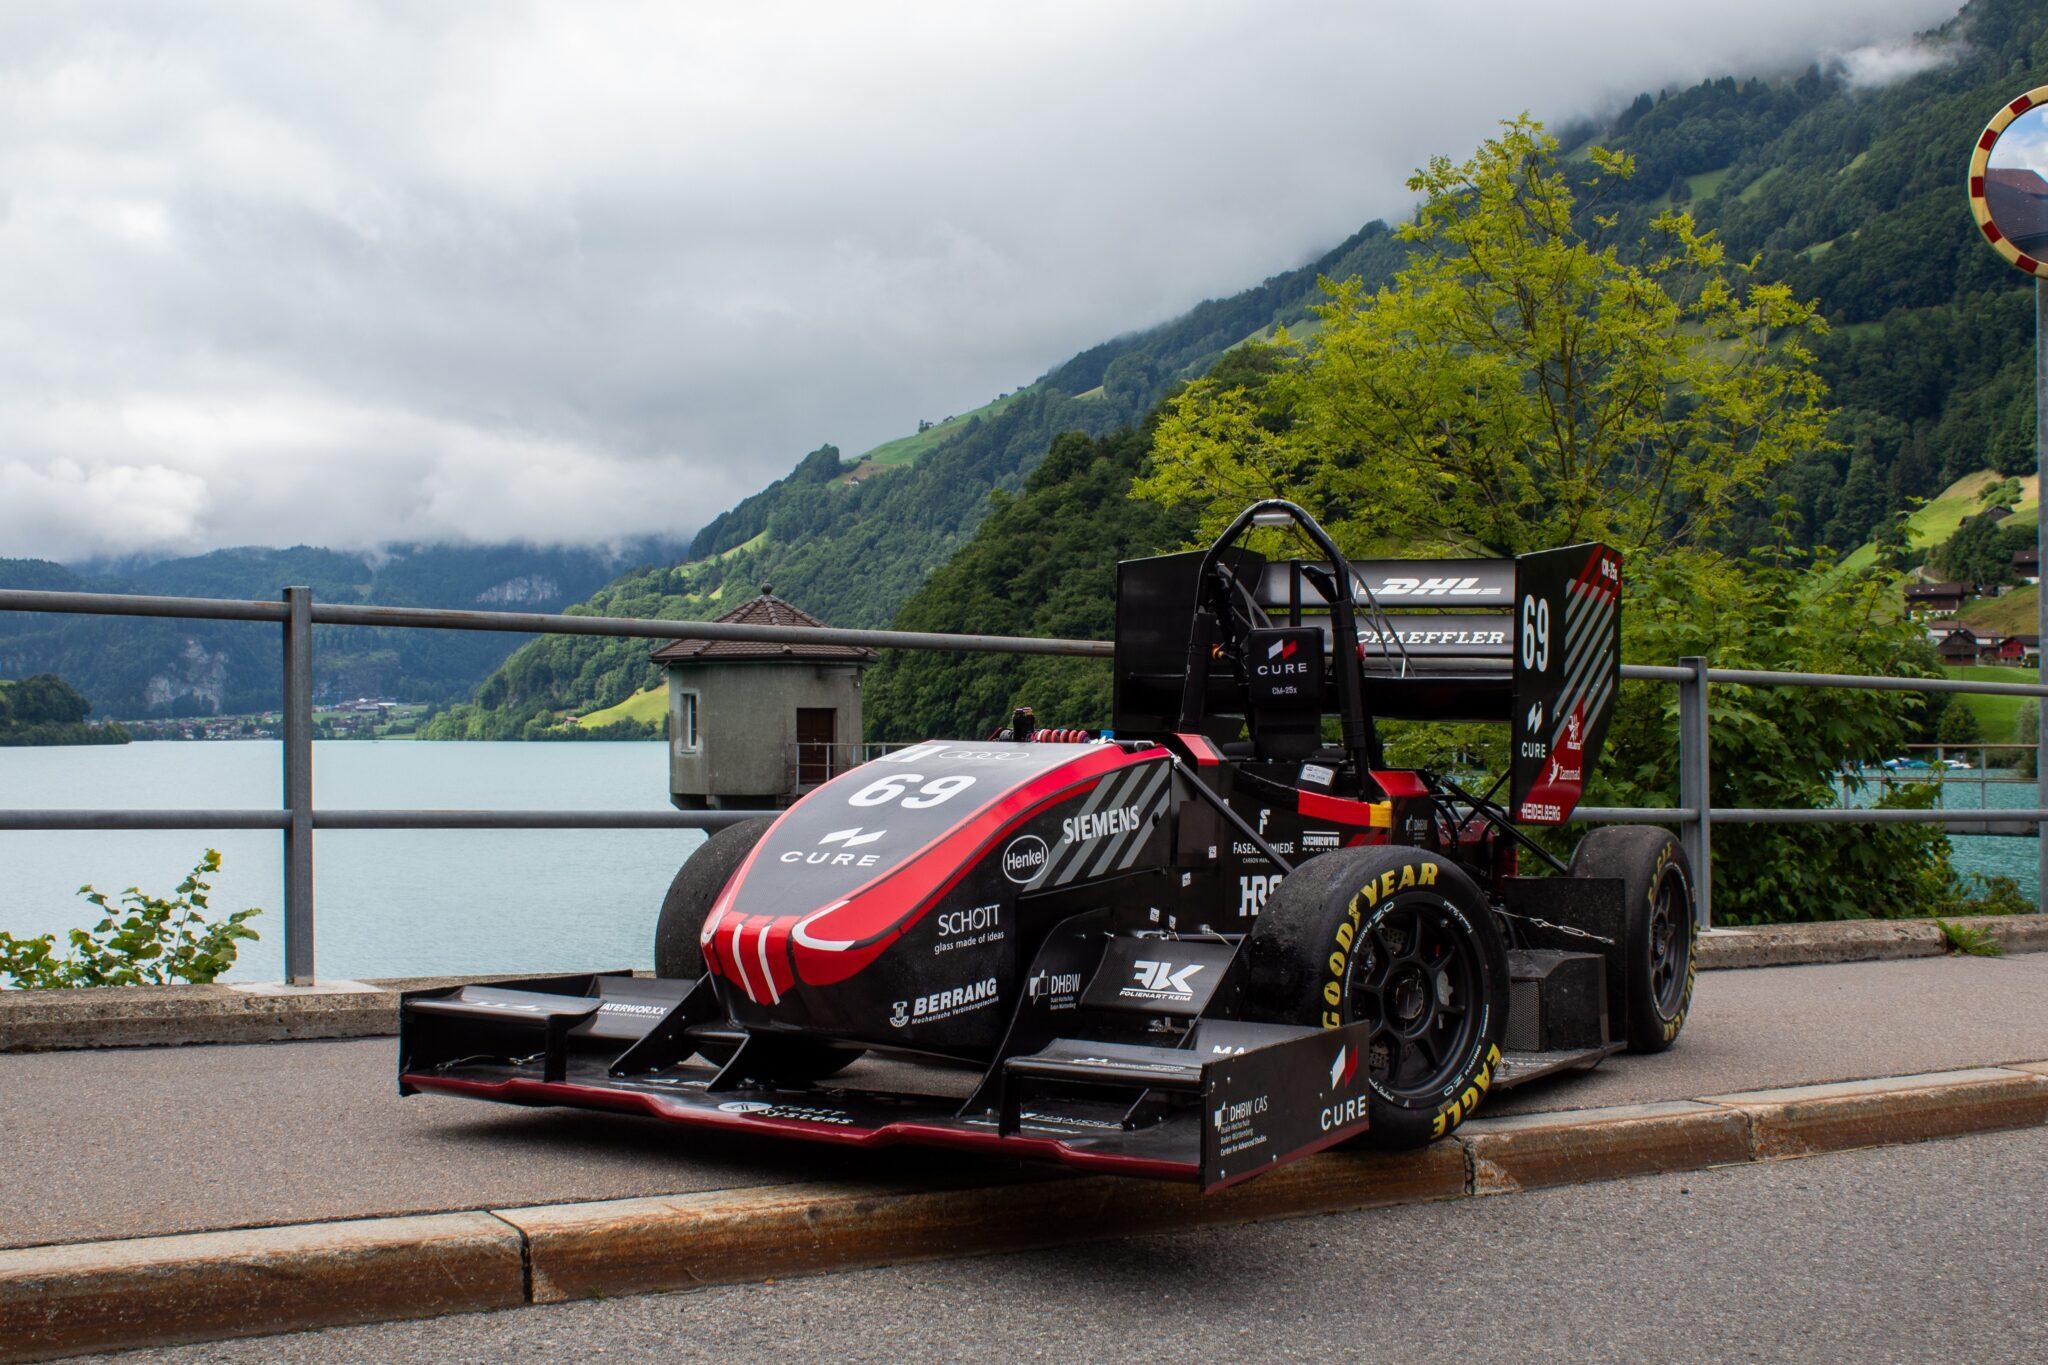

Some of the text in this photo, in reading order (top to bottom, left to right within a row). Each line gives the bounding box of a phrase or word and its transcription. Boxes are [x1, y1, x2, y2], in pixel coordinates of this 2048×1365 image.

[1376, 577, 1488, 595] DHL
[1357, 631, 1506, 645] CHAEFFLER
[1522, 594, 1549, 672] 69
[1257, 662, 1308, 675] CURE
[1521, 742, 1546, 758] CURE
[847, 773, 977, 809] 69
[1522, 803, 1561, 821] HEIDELBERG
[1063, 804, 1140, 845] SIEMENS
[1302, 836, 1340, 846] SCHROTH
[779, 850, 881, 867] CURE
[1006, 847, 1046, 872] Henkel
[938, 903, 1000, 937] SCHOTT
[934, 931, 1004, 955] glass made of ideas
[1322, 862, 1438, 1029] GOODYEAR
[1051, 973, 1081, 994] DHBW
[913, 977, 997, 1016] BERRANG
[1119, 991, 1192, 1002] FOLIENART KEIM
[912, 1010, 951, 1025] Mechanische
[1430, 1043, 1501, 1140] EAGLE
[1230, 1095, 1268, 1122] DHBW CAS
[1321, 1095, 1366, 1131] CURE
